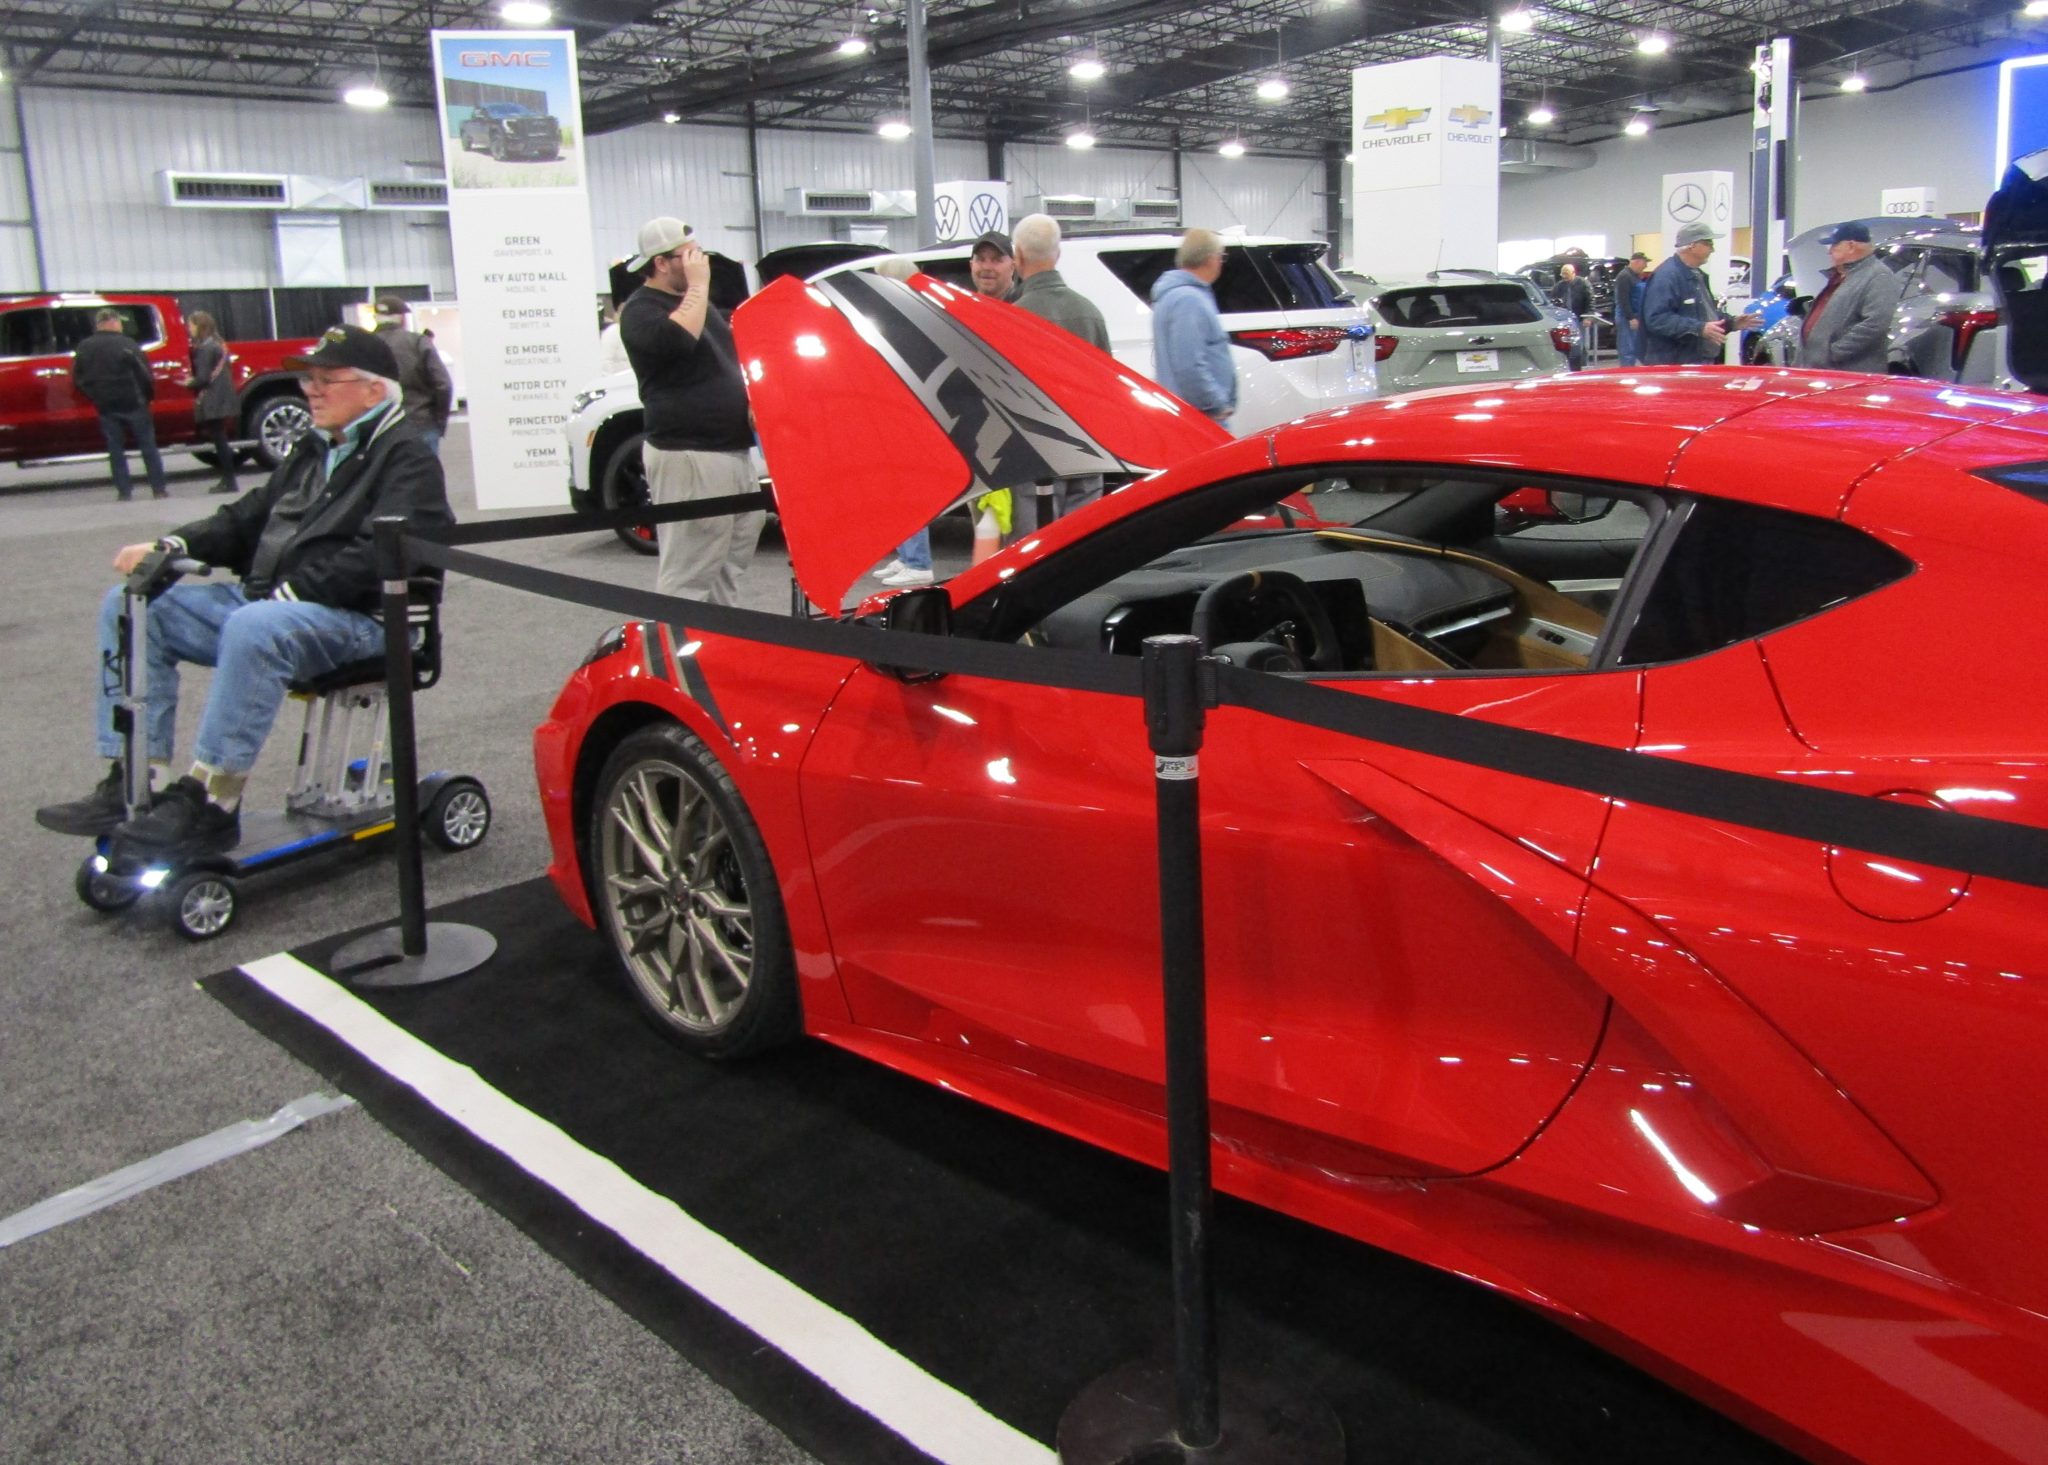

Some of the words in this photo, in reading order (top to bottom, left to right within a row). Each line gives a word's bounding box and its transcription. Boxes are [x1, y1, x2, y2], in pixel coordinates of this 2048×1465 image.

[459, 51, 552, 69] GMC
[1362, 132, 1433, 150] CHEVROLET
[1447, 132, 1493, 144] CHEVROLET
[504, 236, 541, 246] GREEN
[484, 273, 504, 283] KEY
[507, 272, 536, 283] AUTO
[538, 272, 568, 281] MALL
[502, 309, 516, 319] ED
[518, 308, 557, 319] MORSE
[505, 345, 519, 355] ED
[521, 344, 559, 354] MORSE
[503, 380, 541, 391] MOTOR
[543, 379, 567, 389] CITY
[508, 415, 568, 426] PRINCETON
[525, 447, 556, 458] YEMM
